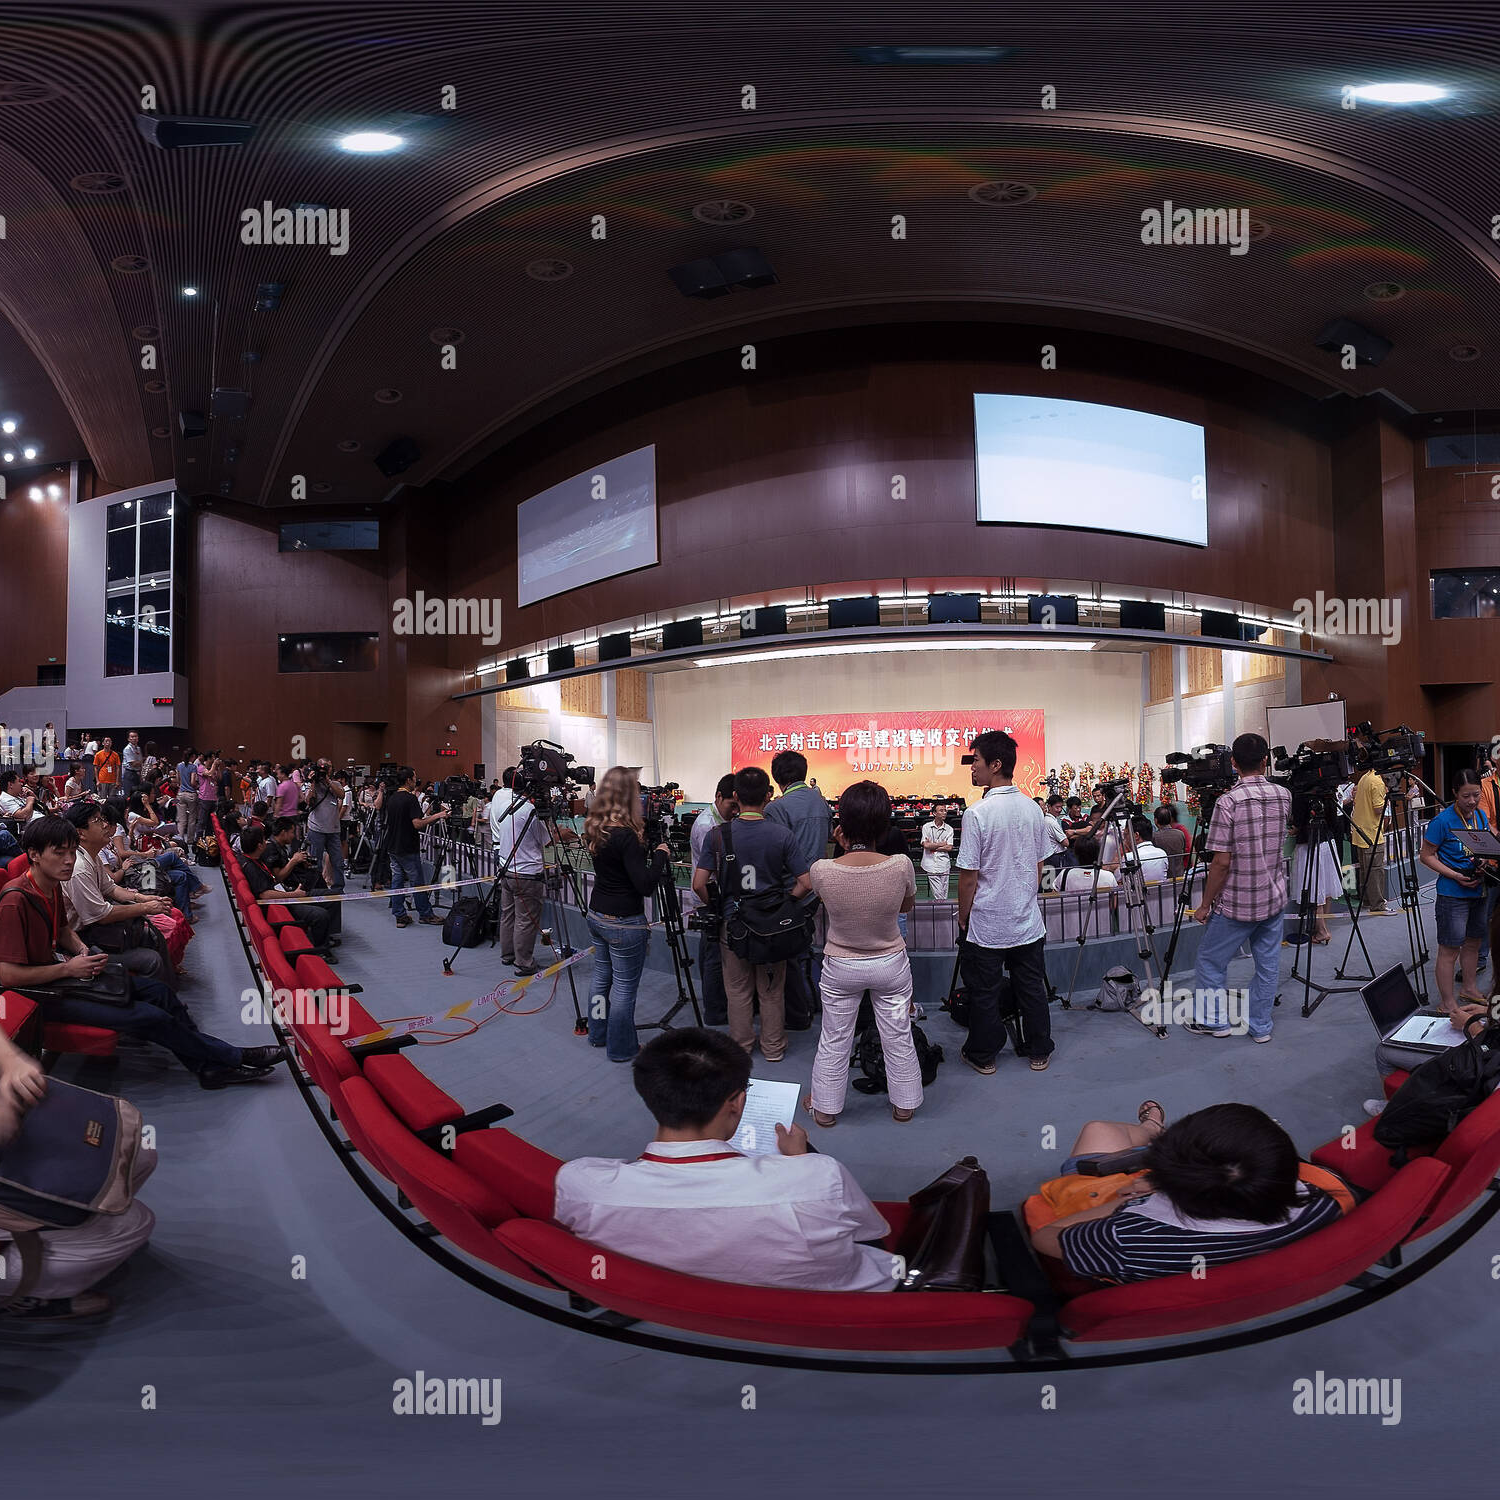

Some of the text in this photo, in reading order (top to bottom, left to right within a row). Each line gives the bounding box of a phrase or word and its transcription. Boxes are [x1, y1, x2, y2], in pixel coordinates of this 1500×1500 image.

[758, 726, 1014, 752] 北京射击馆工程建设验收交付
[852, 760, 914, 773] 2007.7.28
